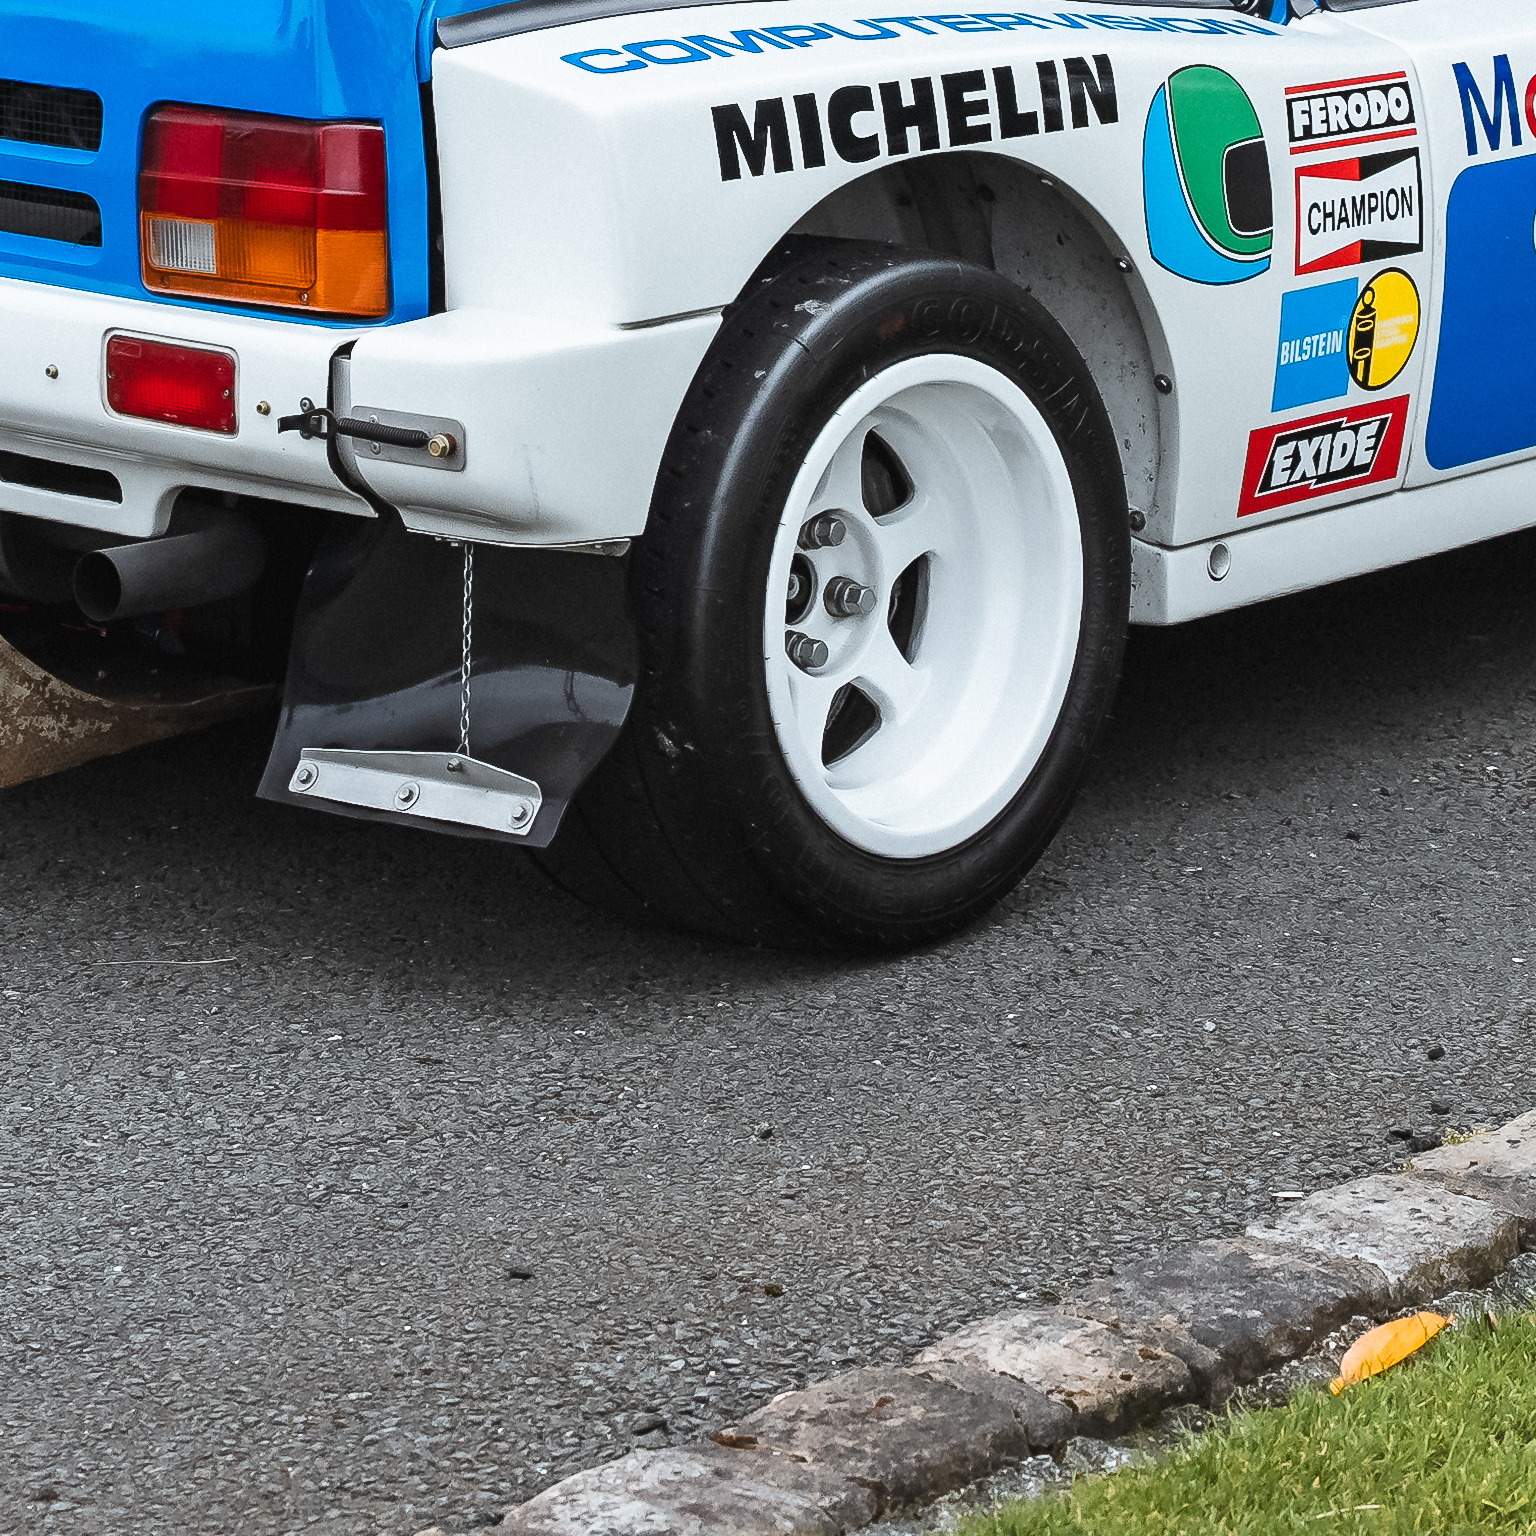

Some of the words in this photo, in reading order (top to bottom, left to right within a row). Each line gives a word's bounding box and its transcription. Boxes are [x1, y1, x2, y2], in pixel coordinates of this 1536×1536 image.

[560, 10, 1282, 74] COMPUTERVISION
[710, 54, 1120, 183] MICHELIN
[1291, 86, 1412, 139] FERODO
[1307, 185, 1413, 235] CHAMPION
[1281, 329, 1344, 365] BILSTEIN
[1272, 420, 1380, 488] EXIDE
